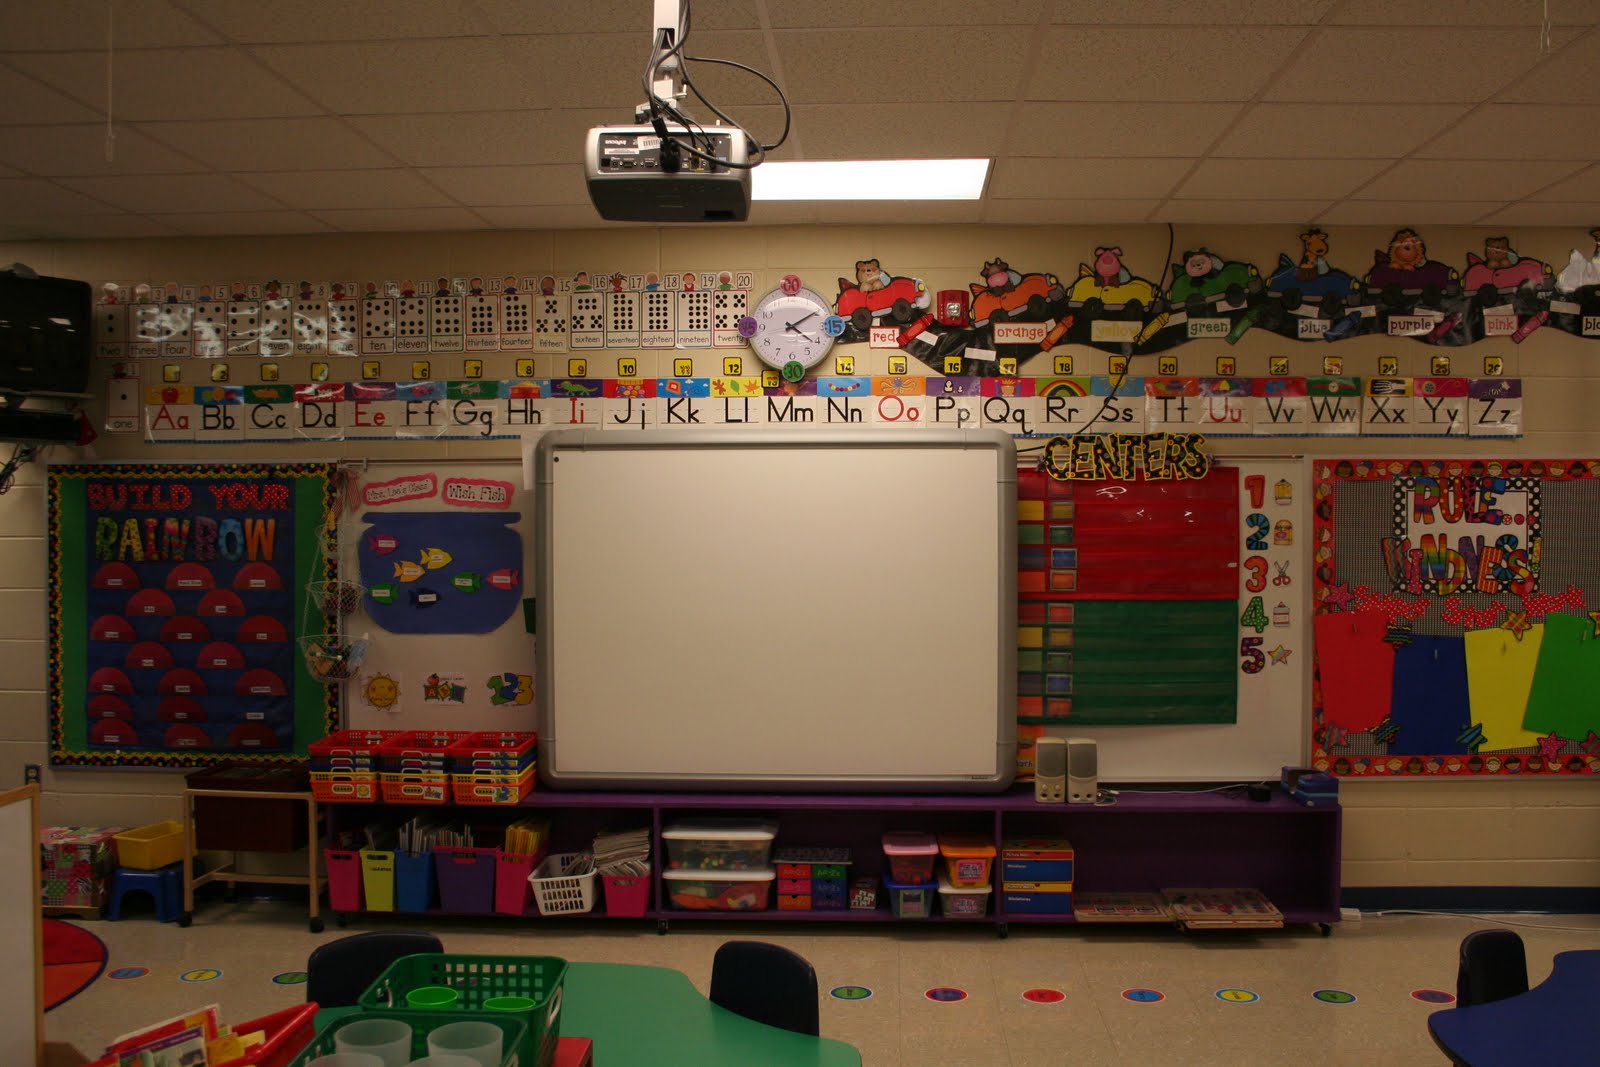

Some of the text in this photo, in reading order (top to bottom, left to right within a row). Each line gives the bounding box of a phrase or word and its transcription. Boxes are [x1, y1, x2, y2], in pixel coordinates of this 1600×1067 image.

[454, 281, 465, 293] 12
[491, 280, 500, 291] 13
[524, 280, 534, 290] 14
[560, 281, 570, 291] 15
[595, 278, 606, 288] 16
[631, 278, 642, 289] 17
[666, 277, 677, 288] 18
[704, 276, 714, 287] 19
[738, 276, 750, 287] 20
[783, 281, 800, 292] 60
[219, 288, 224, 297] 5
[252, 287, 257, 297] 6
[286, 286, 290, 296] 7
[319, 286, 324, 296] 8
[349, 285, 354, 294] 9
[386, 285, 396, 295] 10
[421, 283, 431, 294] 11
[827, 319, 842, 333] 15
[1190, 322, 1229, 335] green
[1300, 320, 1327, 333] blue
[1390, 320, 1432, 335] purple
[1487, 320, 1515, 332] pink
[873, 331, 896, 342] red
[997, 328, 1044, 339] orange
[398, 339, 426, 348] eleven
[434, 339, 459, 348] twelve
[468, 336, 497, 346] thirteen
[502, 336, 532, 346] fourteen
[540, 338, 563, 348] fifteen
[575, 335, 600, 344] sixteen
[608, 336, 638, 344] seventeen
[643, 335, 673, 345] eighteen
[680, 335, 709, 344] nineteen
[718, 335, 743, 344] twenty
[764, 338, 770, 346] 8
[815, 336, 820, 344] 4
[130, 344, 157, 355] three
[166, 344, 188, 354] four
[369, 341, 386, 350] ten
[776, 348, 781, 356] 7
[789, 353, 796, 361] 6
[805, 348, 810, 356] 5
[372, 368, 378, 376] 5
[422, 369, 428, 377] 6
[474, 367, 480, 376] 7
[526, 366, 532, 374] 8
[577, 366, 585, 375] 9
[623, 364, 634, 374] 10
[728, 364, 740, 373] 12
[787, 366, 800, 378] 30
[840, 364, 852, 372] 14
[894, 363, 905, 372] 15
[948, 363, 960, 372] 16
[1004, 364, 1015, 372] 17
[1060, 363, 1070, 372] 18
[1162, 364, 1175, 372] 20
[1222, 364, 1233, 372] 21
[1274, 364, 1286, 372] 22
[1382, 364, 1394, 374] 24
[1436, 364, 1448, 373] 25
[220, 370, 226, 380] 2
[355, 402, 386, 426] Ee
[406, 400, 439, 425] Ff
[508, 399, 541, 424] Hh
[570, 398, 584, 423] Ii
[614, 398, 645, 430] Jj
[668, 398, 700, 423] Kk
[726, 397, 748, 422] Ll
[768, 396, 814, 422] Mm
[828, 397, 862, 422] Nn
[878, 395, 919, 422] Oo
[936, 396, 970, 428] Pp
[1046, 397, 1078, 422] Rr
[1102, 397, 1133, 422] Ss
[1156, 397, 1188, 422] Tt
[1210, 397, 1242, 422] Uu
[1265, 397, 1294, 422] Vv
[1310, 396, 1356, 422] Ww
[1370, 397, 1405, 422] Xx
[1478, 398, 1511, 424] Zz
[152, 406, 189, 429] Aa
[204, 404, 235, 430] Bb
[252, 404, 286, 428] Cc
[302, 402, 336, 428] Dd
[453, 400, 492, 436] Gg
[984, 396, 1033, 434] Qq
[1424, 397, 1458, 434] Yy
[1045, 432, 1208, 481] CENTERS
[87, 483, 289, 511] BUILD YOUR
[450, 485, 505, 500] Wish Fish
[1245, 475, 1265, 508] 1
[1246, 513, 1270, 550] 2
[96, 516, 276, 562] RAINBOW
[1244, 556, 1268, 592] 3
[1241, 596, 1268, 633] 4
[1240, 637, 1266, 674] 5
